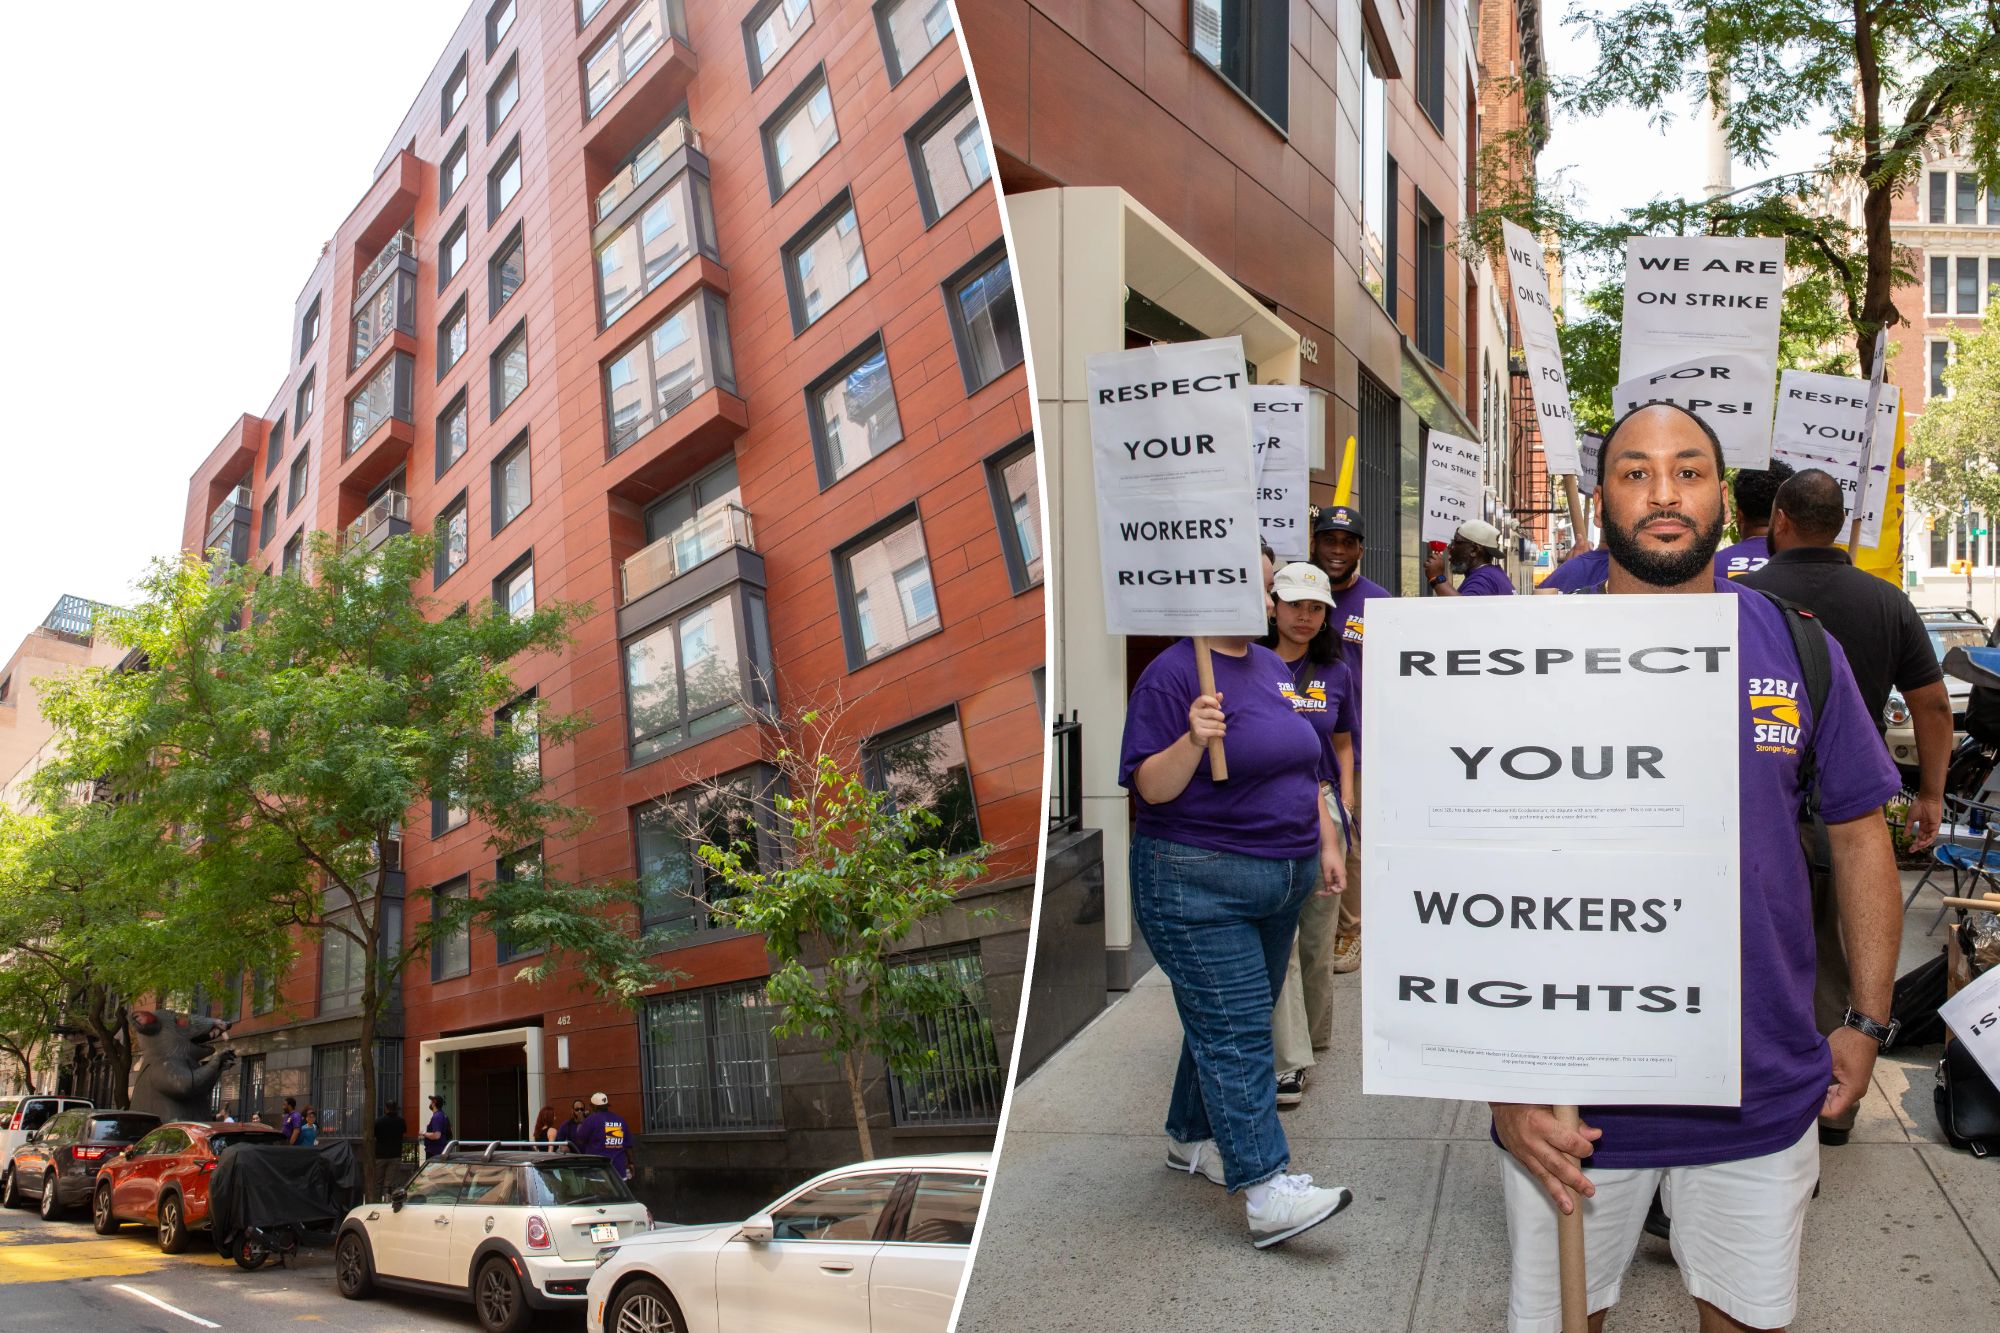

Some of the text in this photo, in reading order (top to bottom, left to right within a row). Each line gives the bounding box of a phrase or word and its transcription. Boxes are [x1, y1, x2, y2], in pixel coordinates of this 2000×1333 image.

[1509, 246, 1532, 267] WE
[1639, 257, 1777, 275] WE ARE
[1518, 286, 1535, 304] ON
[1637, 290, 1769, 310] ON STRIKE
[1300, 337, 1318, 364] 462
[1650, 366, 1731, 385] FOR
[1098, 372, 1241, 405] RESPECT
[1123, 433, 1215, 461] YOUR
[1432, 442, 1480, 462] WE ARE
[1431, 459, 1477, 478] ON STRIKE
[1440, 495, 1466, 508] FOR
[1430, 509, 1467, 524] ULPs
[1120, 517, 1235, 542] WORKERS'
[1728, 557, 1769, 572] 32
[1118, 567, 1248, 586] RIGHTS!
[1399, 646, 1731, 677] RESPECT
[1748, 678, 1799, 699] 32BJ
[1753, 724, 1801, 745] SEIU
[1449, 745, 1666, 780] YOUR
[1413, 890, 1683, 934] WORKERS'
[1398, 975, 1703, 1015] RIGHTS!
[557, 1015, 572, 1026] 462
